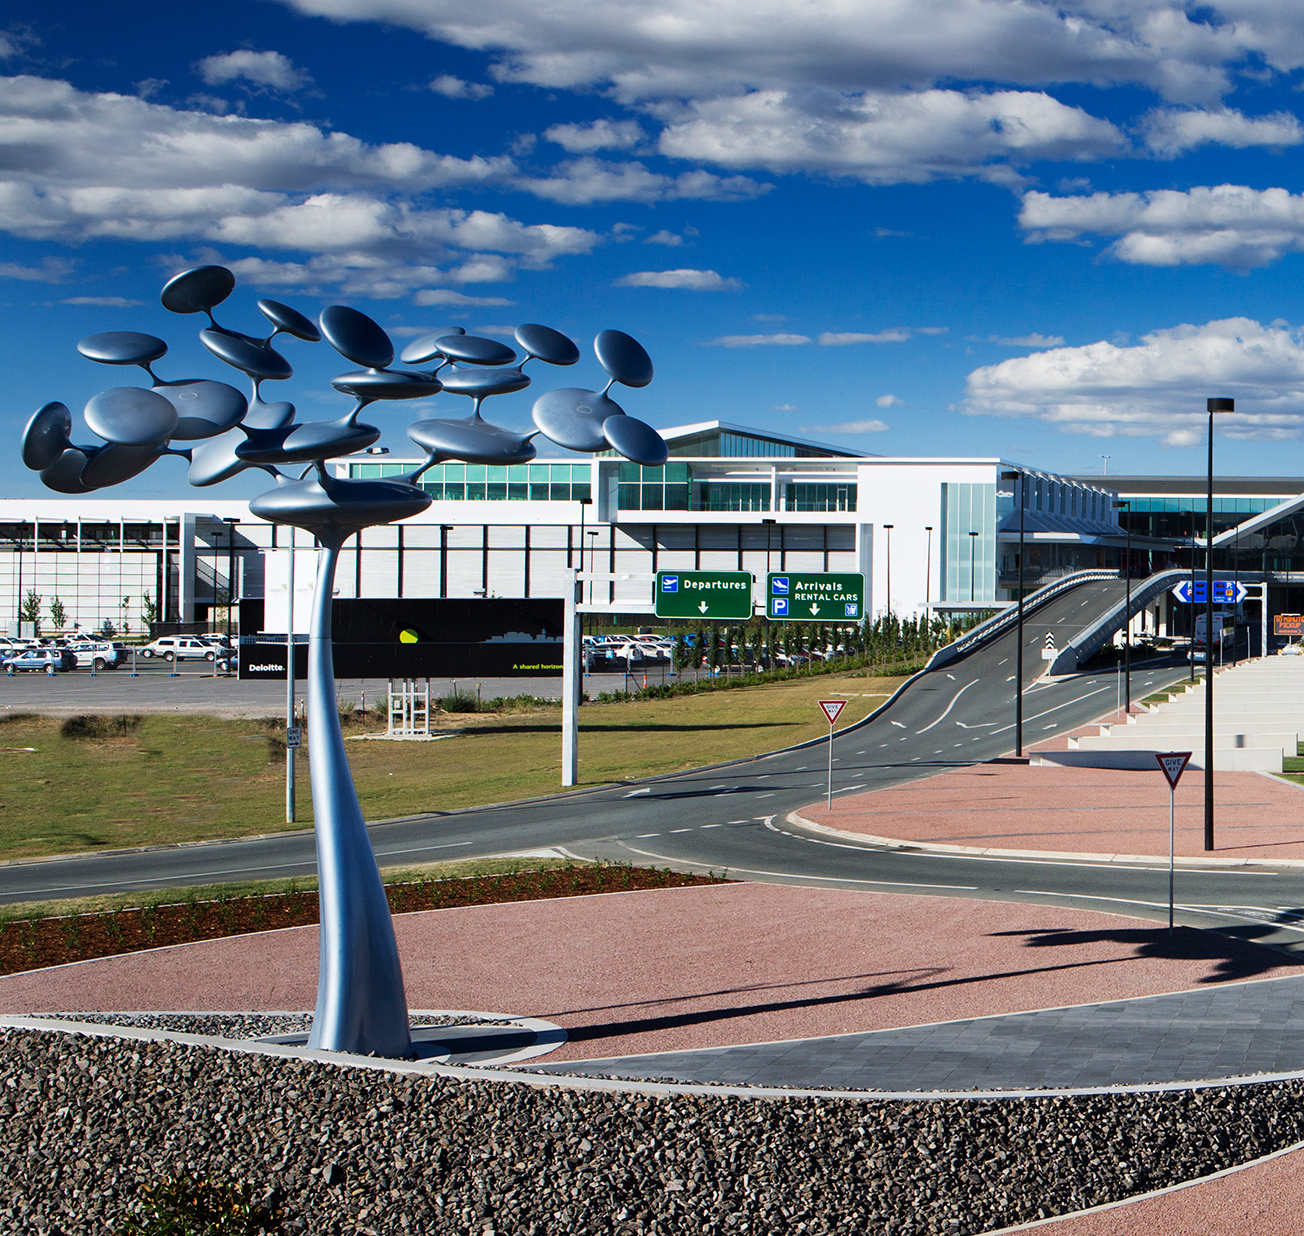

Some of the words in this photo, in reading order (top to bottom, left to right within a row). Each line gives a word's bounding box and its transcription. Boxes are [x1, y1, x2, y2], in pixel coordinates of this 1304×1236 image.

[683, 579, 747, 591] Departures
[795, 581, 843, 591] Arrivals
[794, 593, 831, 601] RENTAL
[833, 593, 858, 601] CARS
[774, 600, 786, 614] P
[1165, 758, 1182, 766] GIVE
